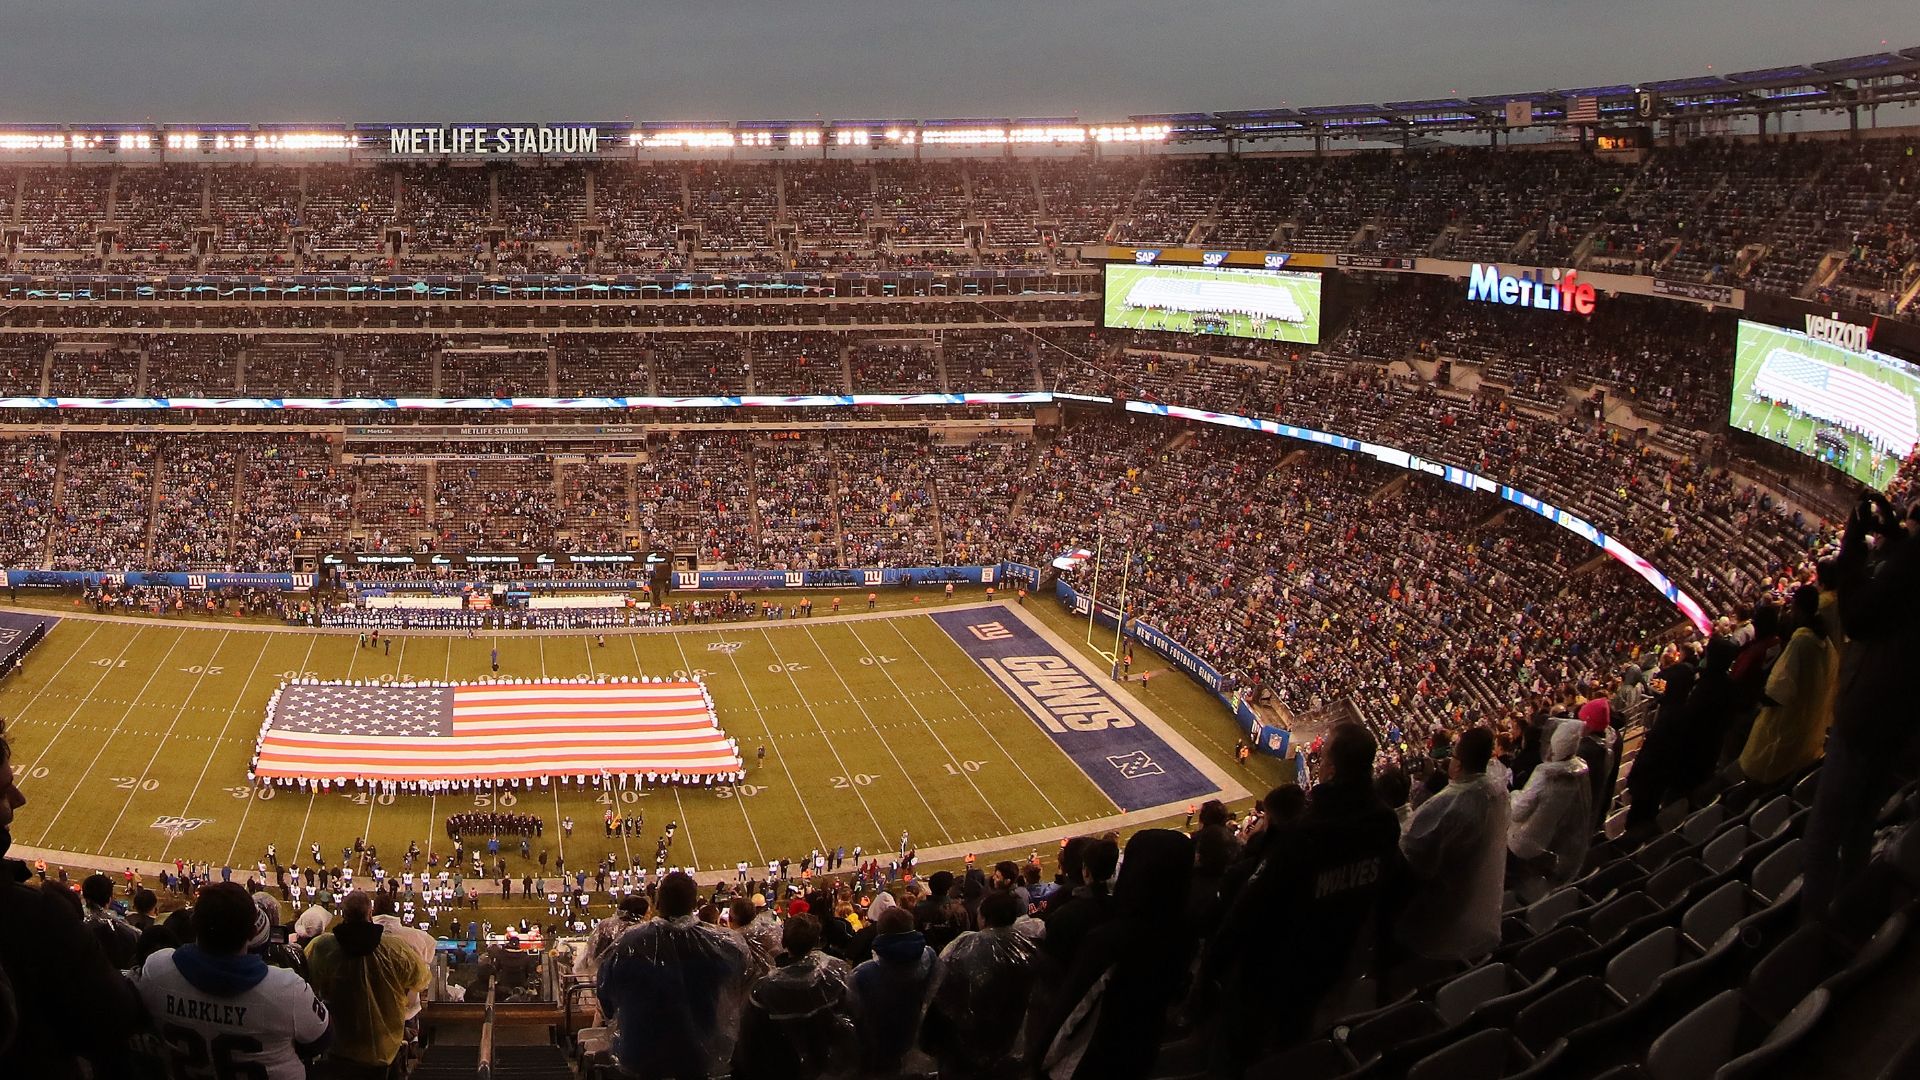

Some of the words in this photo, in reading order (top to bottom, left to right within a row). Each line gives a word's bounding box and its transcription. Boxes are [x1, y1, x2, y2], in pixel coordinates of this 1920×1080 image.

[391, 128, 488, 154] METLIFE
[496, 128, 597, 154] STADIUM
[1135, 251, 1156, 263] SAP
[1203, 253, 1223, 265] SAP
[1264, 256, 1284, 268] SAP
[1467, 264, 1596, 315] MetLife
[1805, 312, 1868, 354] verizon
[187, 574, 207, 590] ny
[292, 574, 314, 591] ny
[679, 573, 699, 588] ny
[785, 573, 803, 587] ny
[864, 571, 882, 585] ny
[1076, 596, 1089, 615] ny
[967, 621, 1014, 641] ny
[1136, 626, 1151, 641] NEW
[1153, 634, 1169, 652] YORK
[1170, 645, 1197, 672] FOOTBALL
[1198, 666, 1217, 689] GIANTS
[1000, 655, 1136, 732] GIANTS
[12, 764, 49, 779] 10
[943, 760, 980, 775] 10
[117, 776, 160, 791] 20
[830, 773, 873, 789] 20
[232, 786, 276, 800] 30
[352, 791, 395, 806] 40
[474, 790, 517, 807] 50
[596, 791, 639, 805] 40
[716, 784, 758, 799] 30
[167, 995, 248, 1026] BARKLEY
